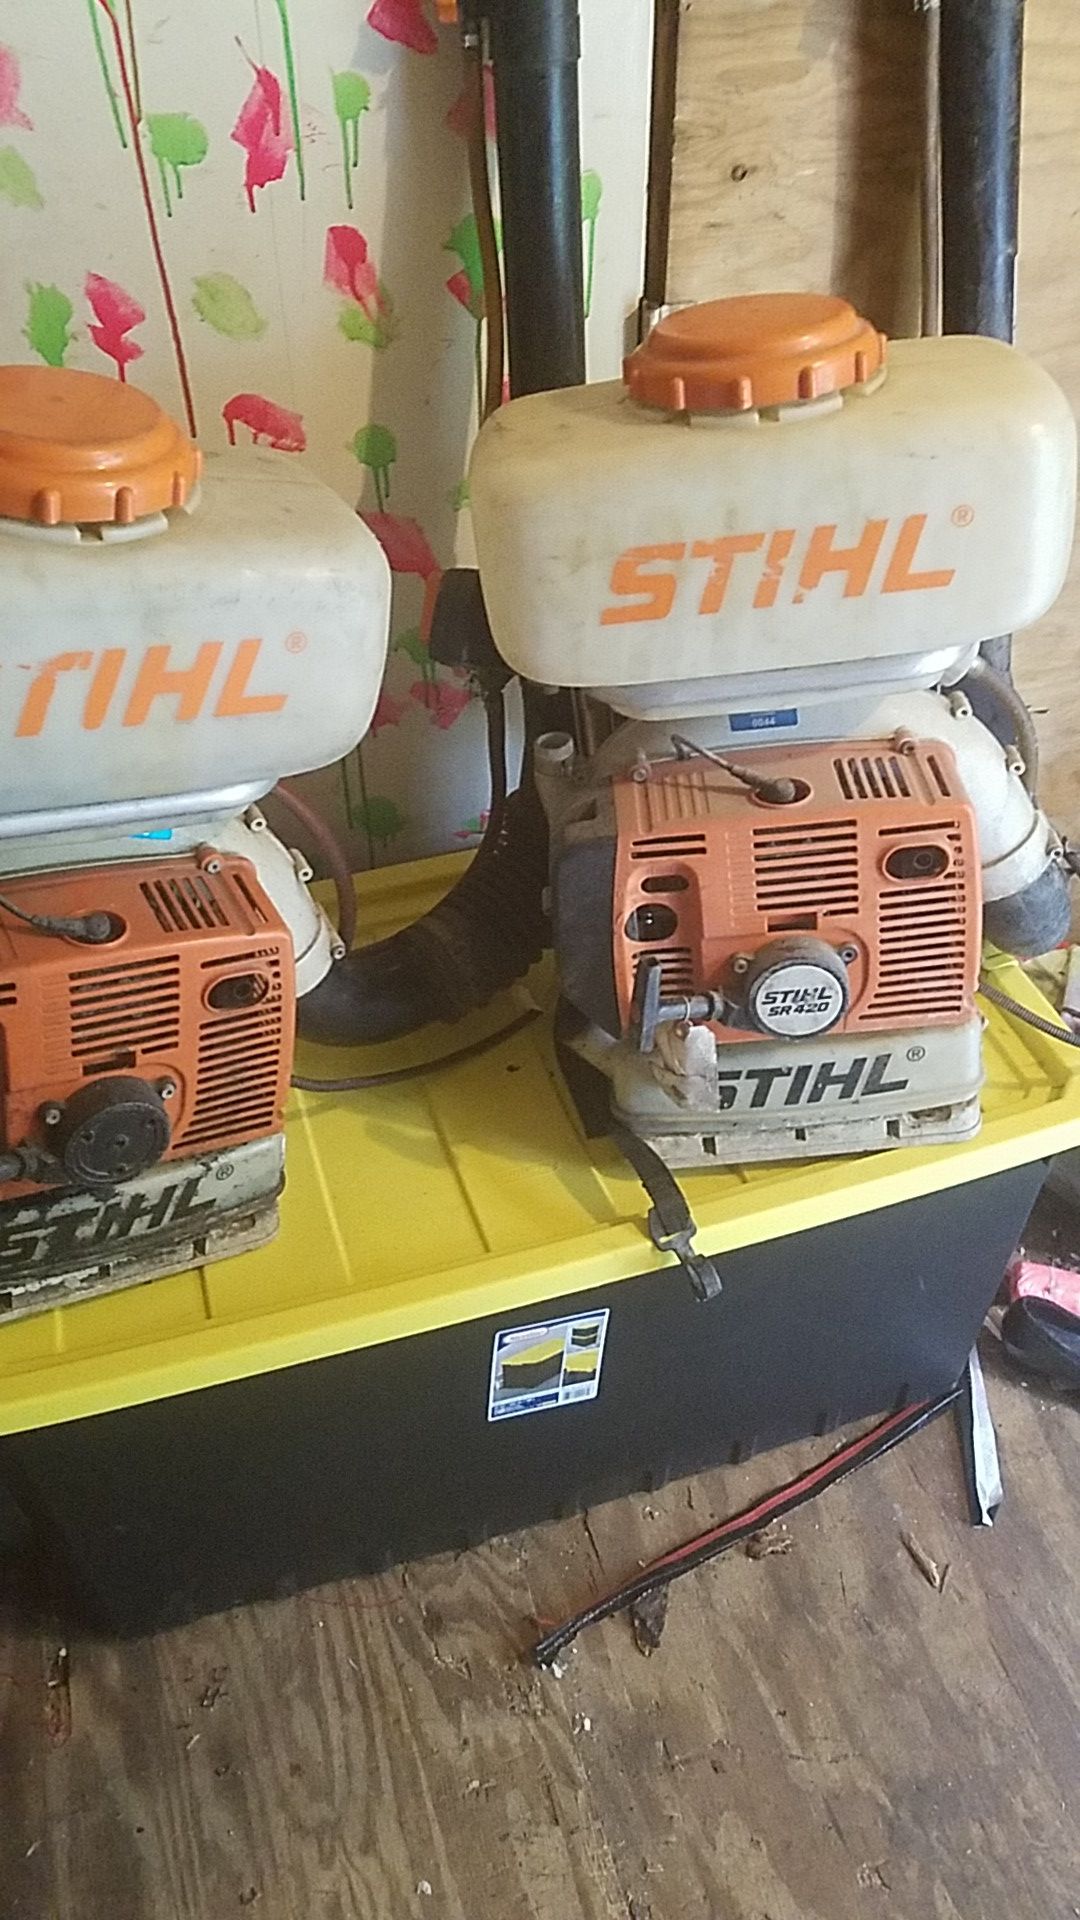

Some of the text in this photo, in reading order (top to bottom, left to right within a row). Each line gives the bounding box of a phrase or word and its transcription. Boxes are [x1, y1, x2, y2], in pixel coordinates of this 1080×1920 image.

[599, 512, 956, 626] STIHL
[12, 638, 288, 738] TIHL
[762, 987, 832, 1005] STIHL
